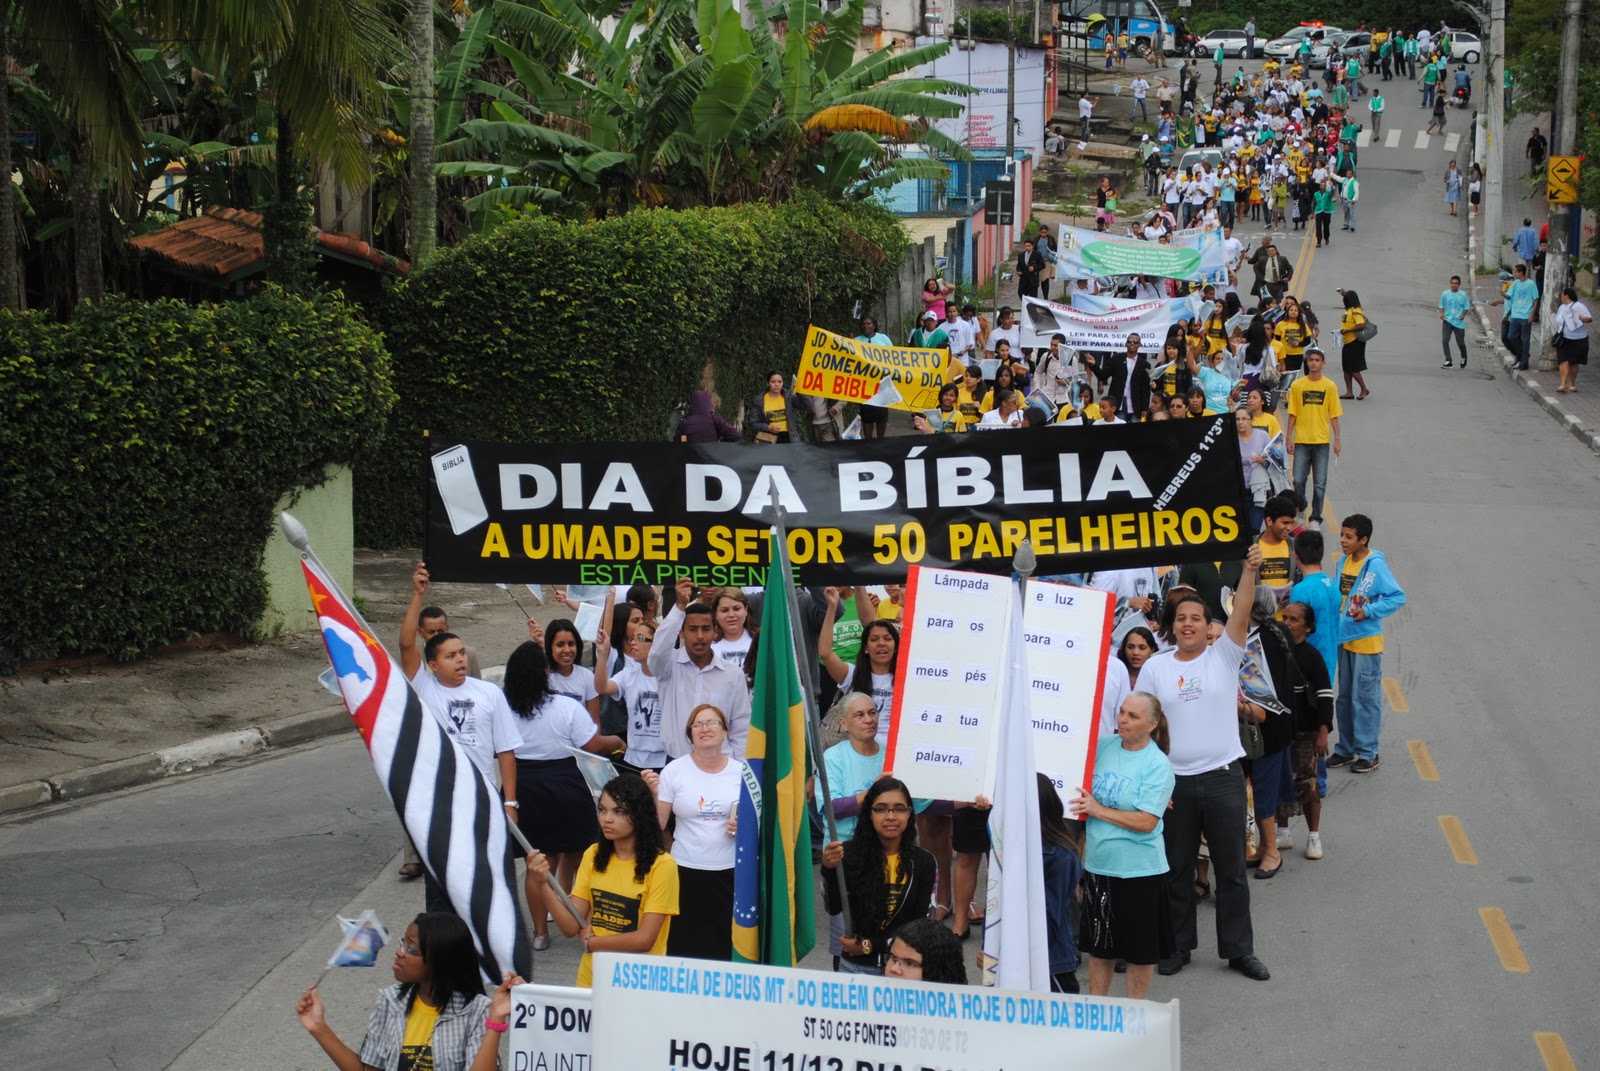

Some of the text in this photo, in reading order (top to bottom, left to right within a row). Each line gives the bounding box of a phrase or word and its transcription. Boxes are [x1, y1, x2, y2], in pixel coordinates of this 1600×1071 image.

[1129, 301, 1163, 312] CELESTE
[861, 345, 941, 369] NORBERTO
[802, 370, 880, 400] DA BÍBL
[920, 371, 944, 388] DIA
[499, 446, 1153, 513] DIA DA BÍBLIA
[1153, 452, 1202, 511] HEBREUS
[480, 522, 511, 558] A
[521, 523, 692, 561] UMADEP
[873, 521, 927, 565] 50
[949, 505, 1240, 561] PARELHEIROS
[580, 560, 802, 587] ESTÁ PRESENE
[934, 573, 990, 591] Lâmpada
[1036, 592, 1074, 606] e luz
[927, 615, 985, 632] para os
[1066, 640, 1074, 648] o
[915, 666, 987, 683] meus pés
[1032, 679, 1060, 692] meu
[921, 711, 979, 727] é a tua
[1031, 718, 1069, 733] minho
[915, 749, 963, 766] palavra,
[612, 961, 699, 995] ASSEMBLÉIA
[703, 970, 721, 998] DE
[724, 972, 761, 1002] DEUS
[765, 976, 785, 1004] MT
[797, 979, 817, 1007] DO
[821, 978, 868, 1011] BELÉM
[873, 986, 958, 1018] COMEMORA
[962, 993, 1001, 1022] HOJE
[1005, 997, 1016, 1023] O
[1020, 998, 1046, 1026] DIA
[1050, 1000, 1070, 1028] DA
[1075, 997, 1124, 1033] BÍBLIA
[803, 1016, 816, 1038] ST
[820, 1018, 833, 1040] 50
[836, 1021, 851, 1041] CG
[854, 1022, 897, 1048] FONTES
[514, 1050, 548, 1071] DIA
[669, 1039, 751, 1071] HOJE
